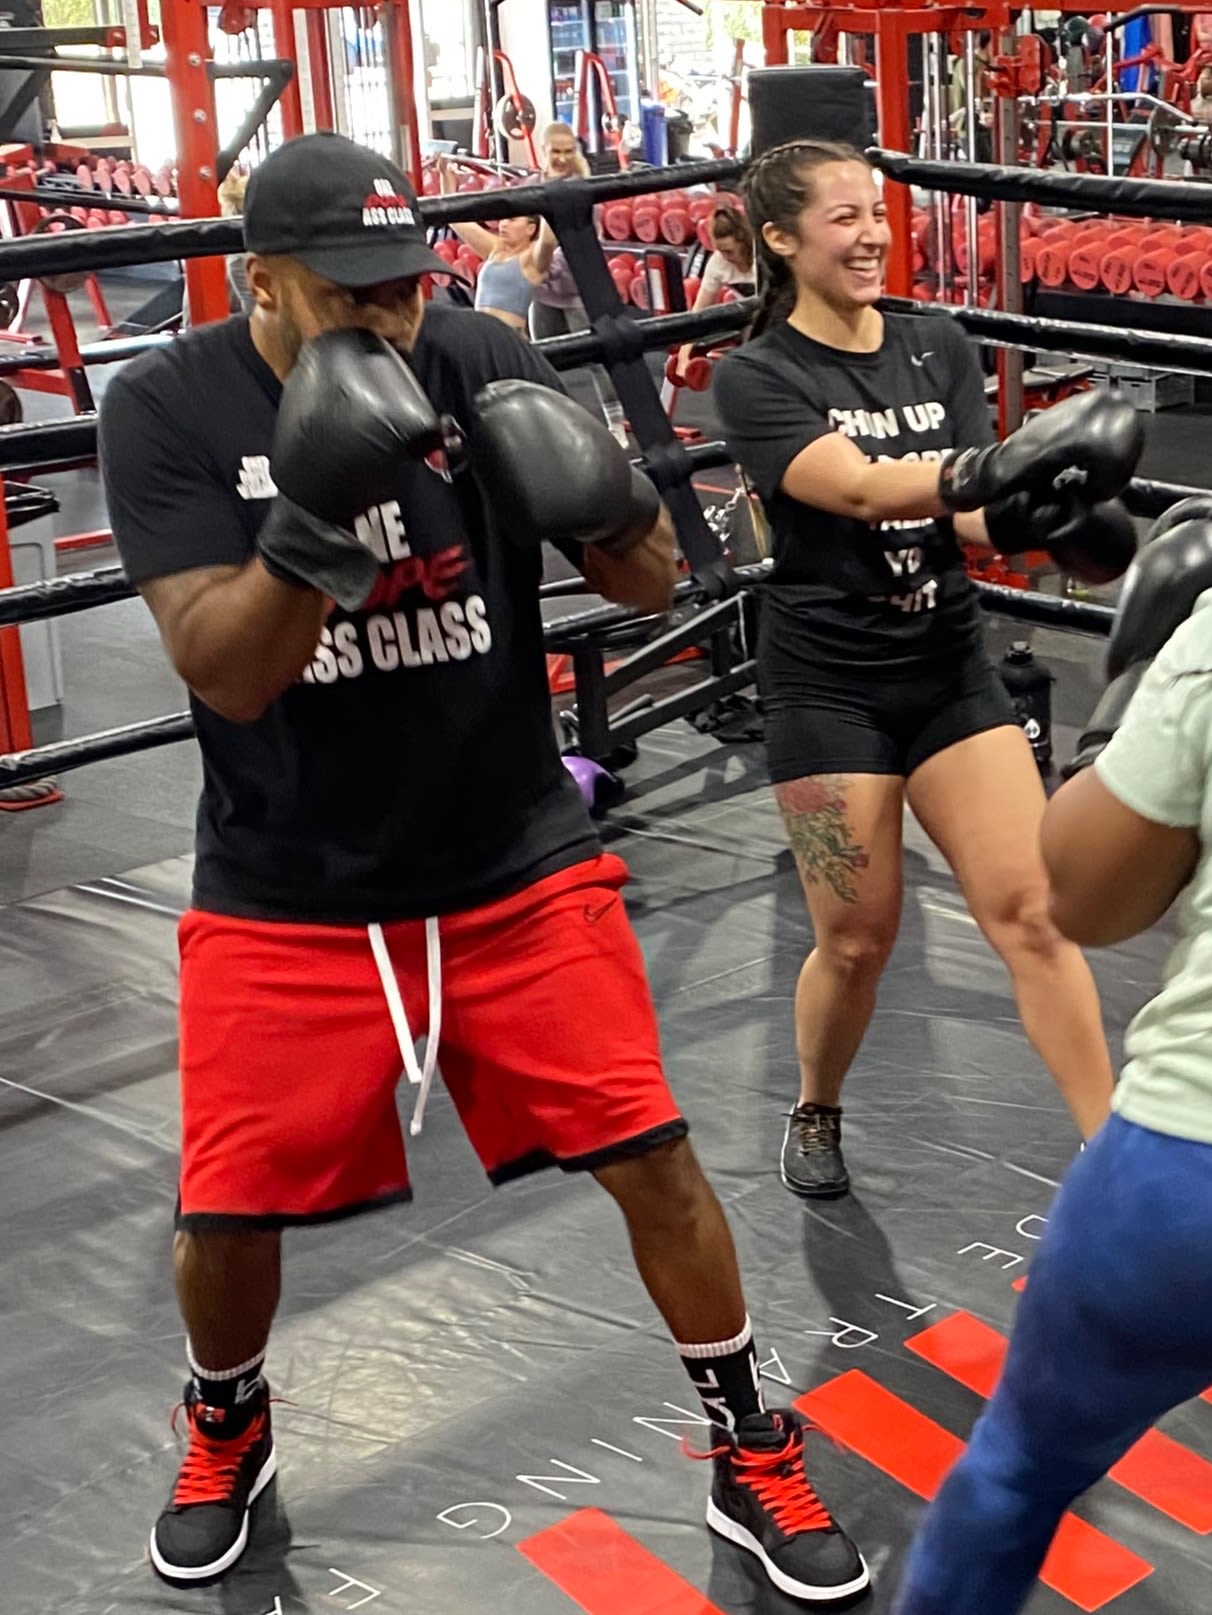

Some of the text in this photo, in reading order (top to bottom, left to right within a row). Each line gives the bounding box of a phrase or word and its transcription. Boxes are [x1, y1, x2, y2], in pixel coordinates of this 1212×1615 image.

[902, 401, 946, 432] UP
[354, 500, 412, 564] NE
[302, 594, 492, 684] SS CLASS
